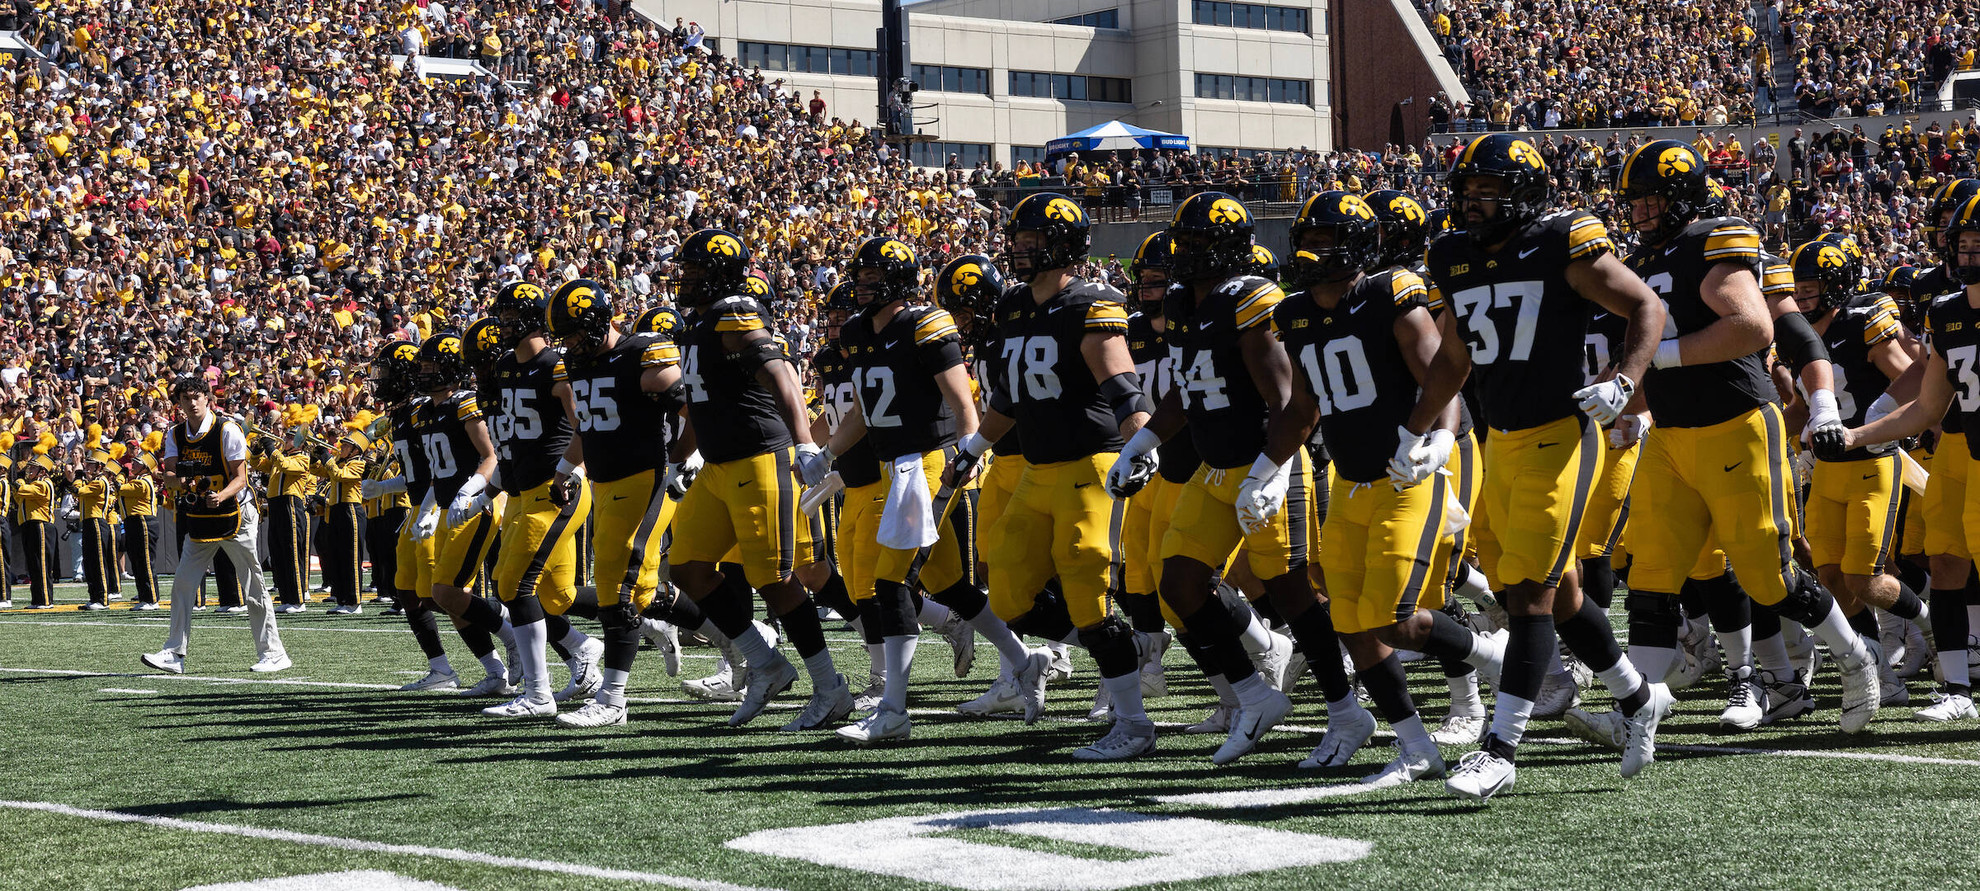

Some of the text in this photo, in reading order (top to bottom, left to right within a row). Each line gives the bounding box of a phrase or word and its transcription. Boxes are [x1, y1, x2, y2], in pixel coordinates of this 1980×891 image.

[1452, 281, 1545, 365] 37
[680, 345, 709, 403] 4
[851, 366, 903, 428] 12
[1000, 335, 1063, 401] 78
[1300, 335, 1378, 417] 10
[501, 388, 543, 440] 85
[572, 376, 621, 432] 65
